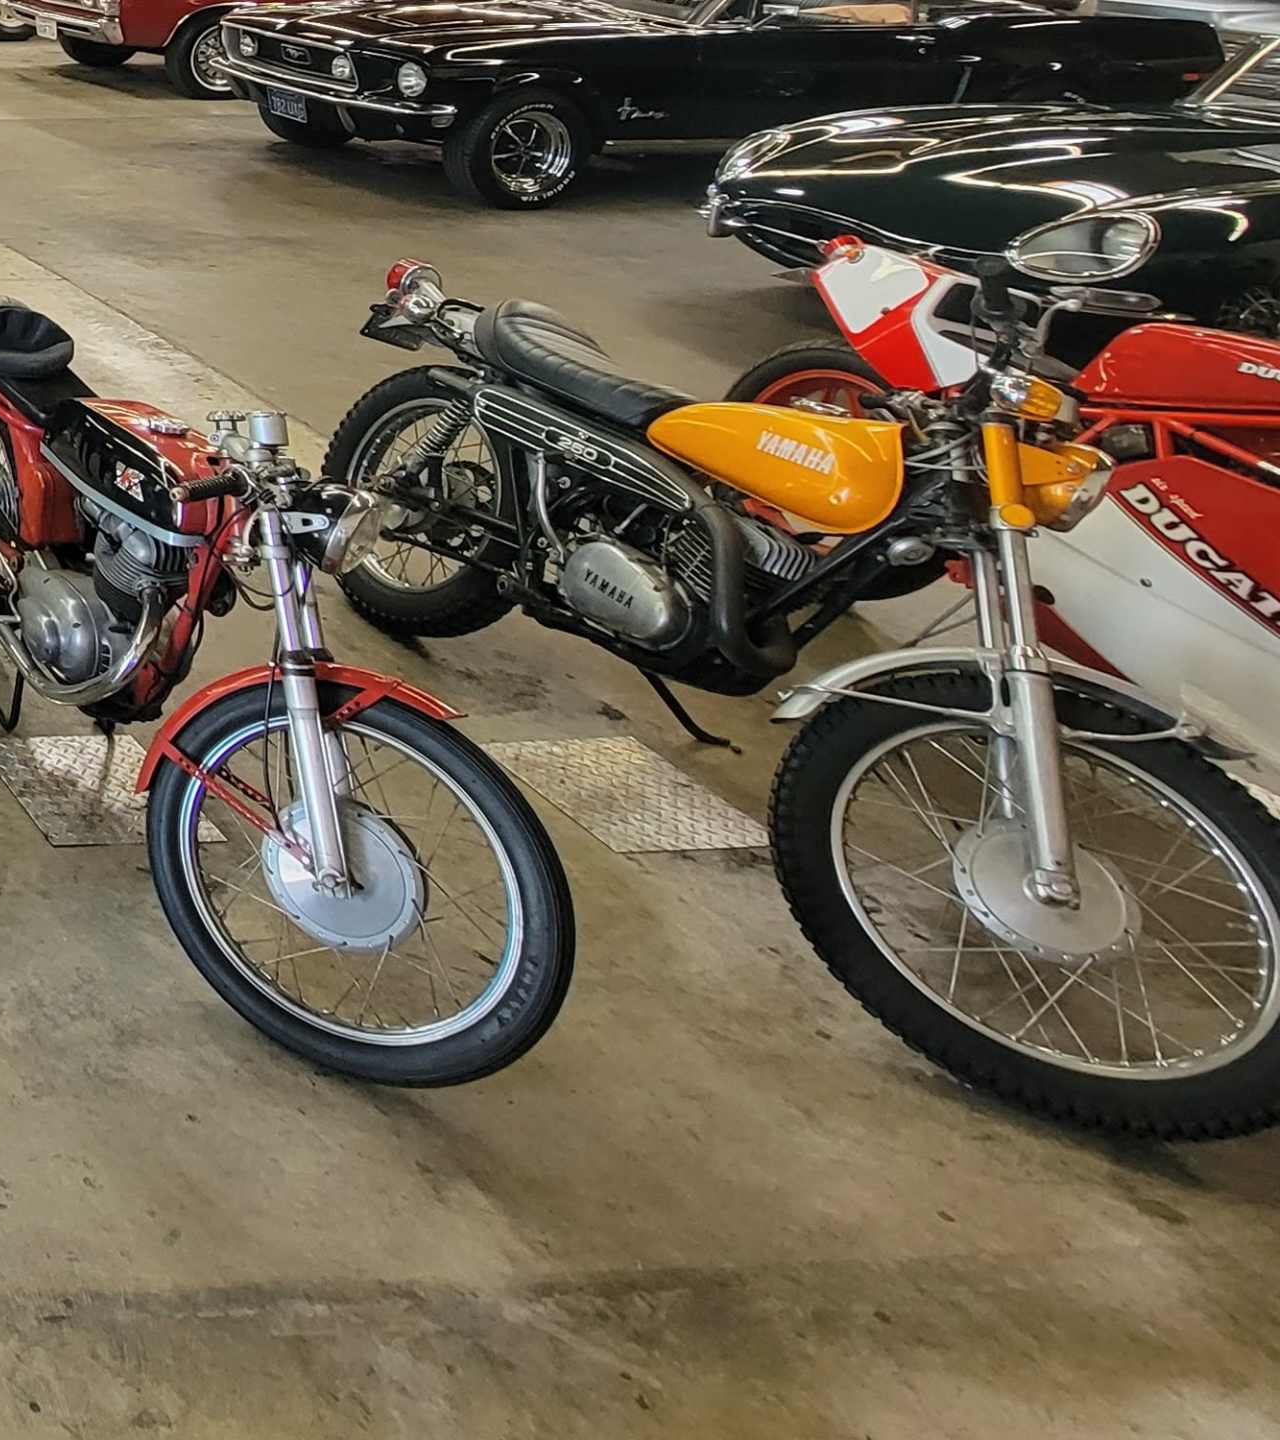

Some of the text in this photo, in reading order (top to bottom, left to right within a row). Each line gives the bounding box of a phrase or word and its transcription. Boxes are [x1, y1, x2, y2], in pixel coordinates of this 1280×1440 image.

[557, 435, 599, 462] 250
[755, 429, 837, 476] YAMAHA
[582, 568, 635, 611] YAMAHA
